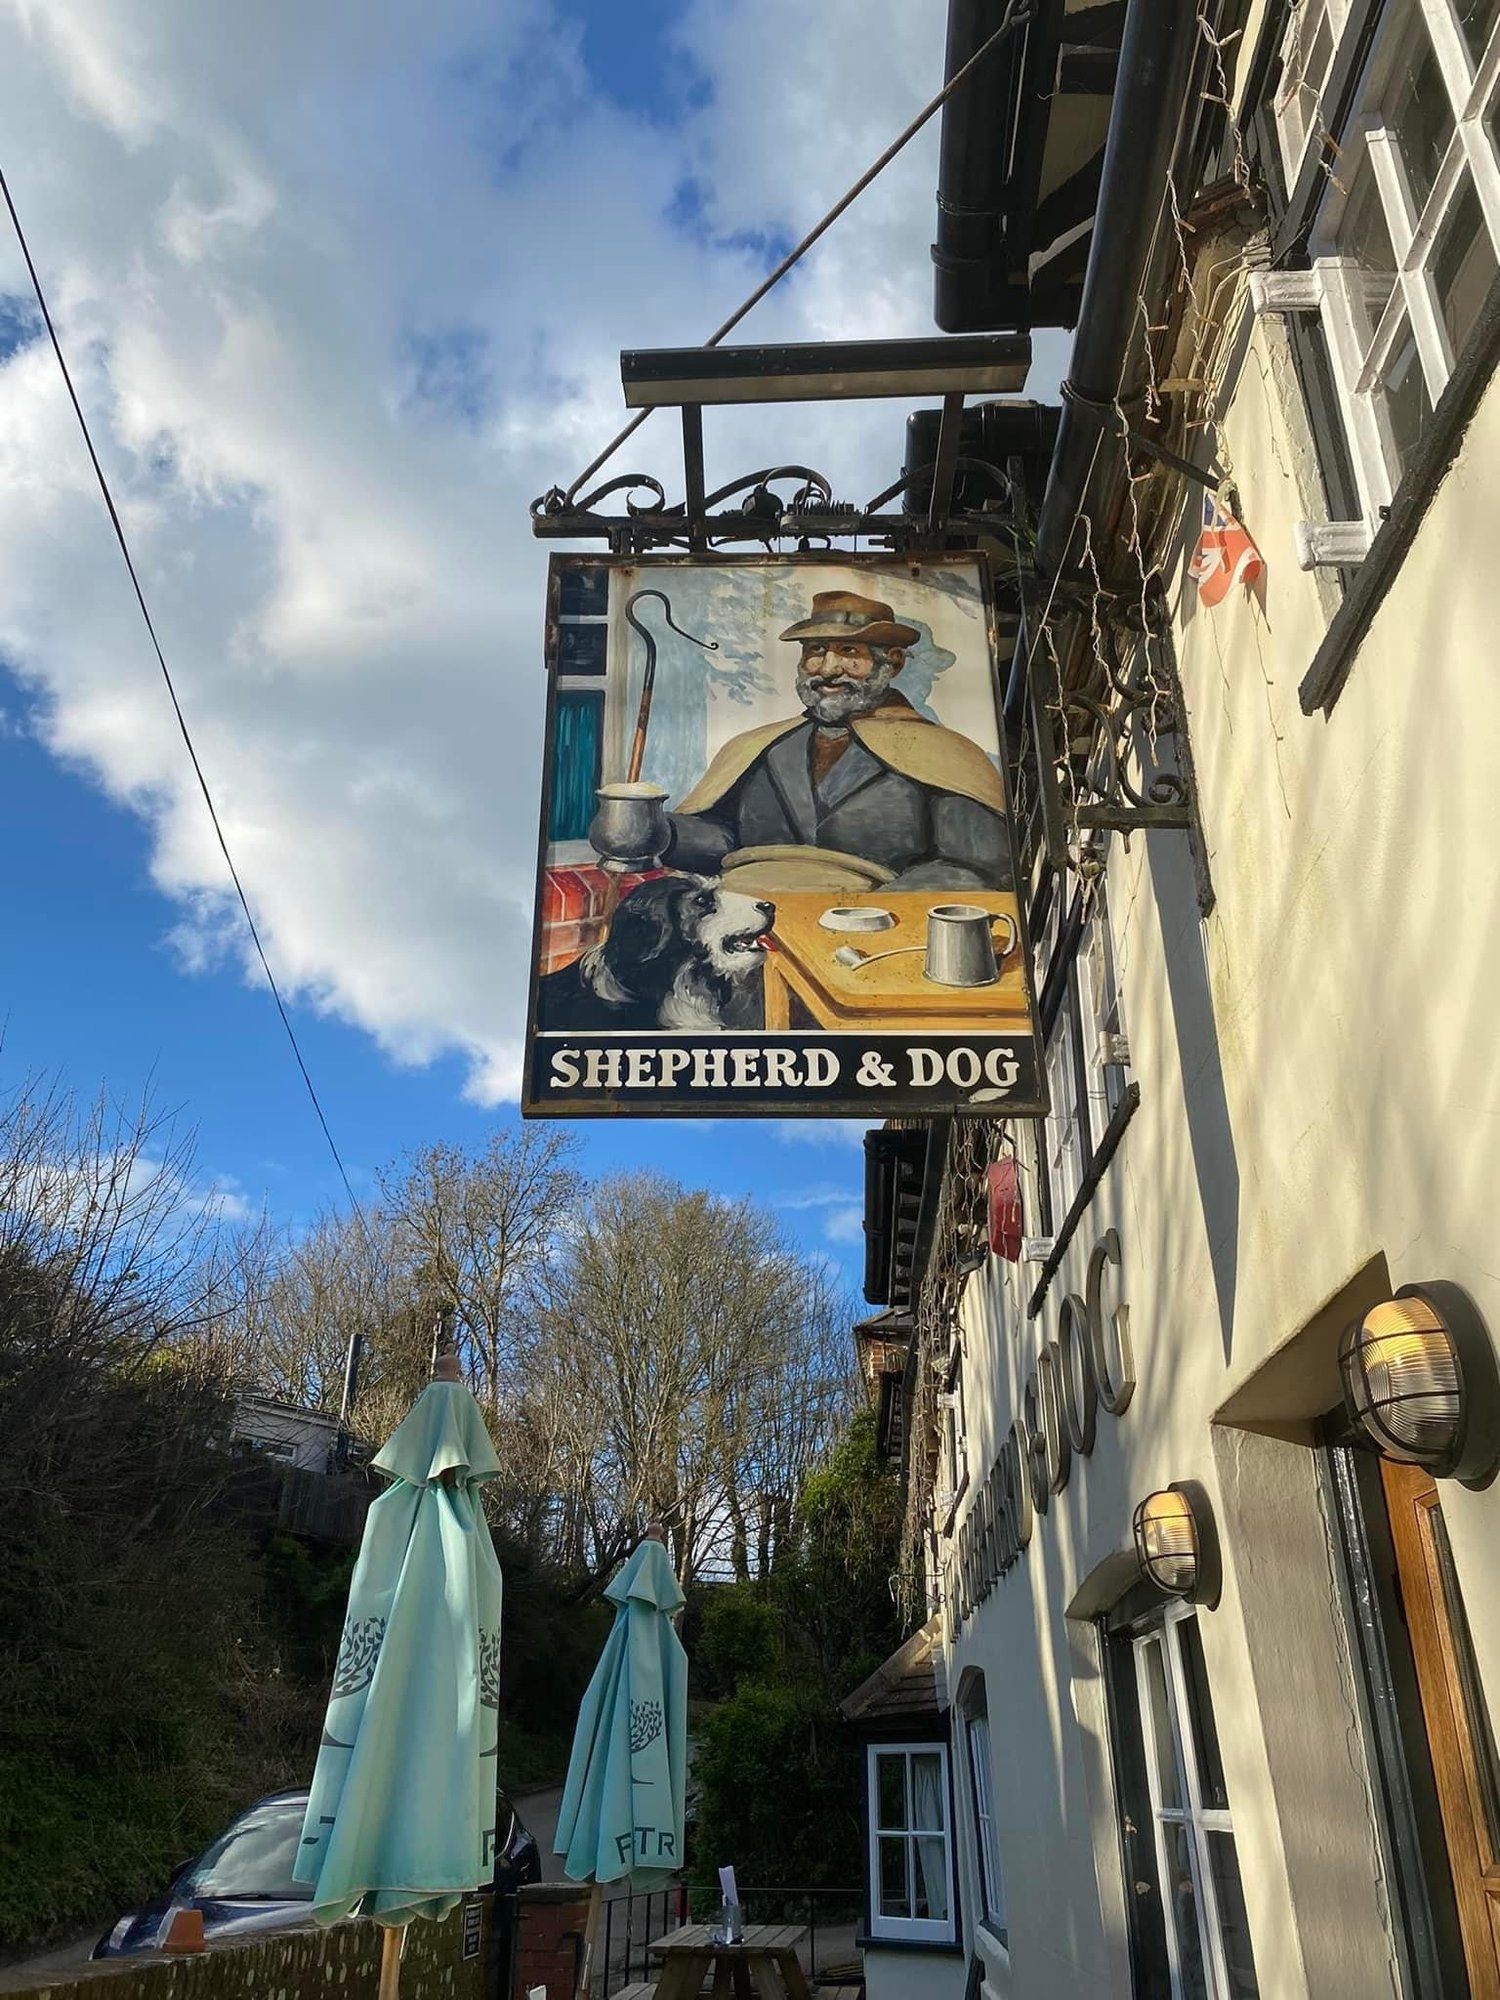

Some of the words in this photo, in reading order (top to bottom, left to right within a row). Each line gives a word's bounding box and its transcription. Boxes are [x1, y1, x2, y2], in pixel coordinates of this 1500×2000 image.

[550, 1047, 841, 1088] SHEPHERD
[855, 1050, 897, 1088] &
[906, 1047, 1020, 1088] DOG
